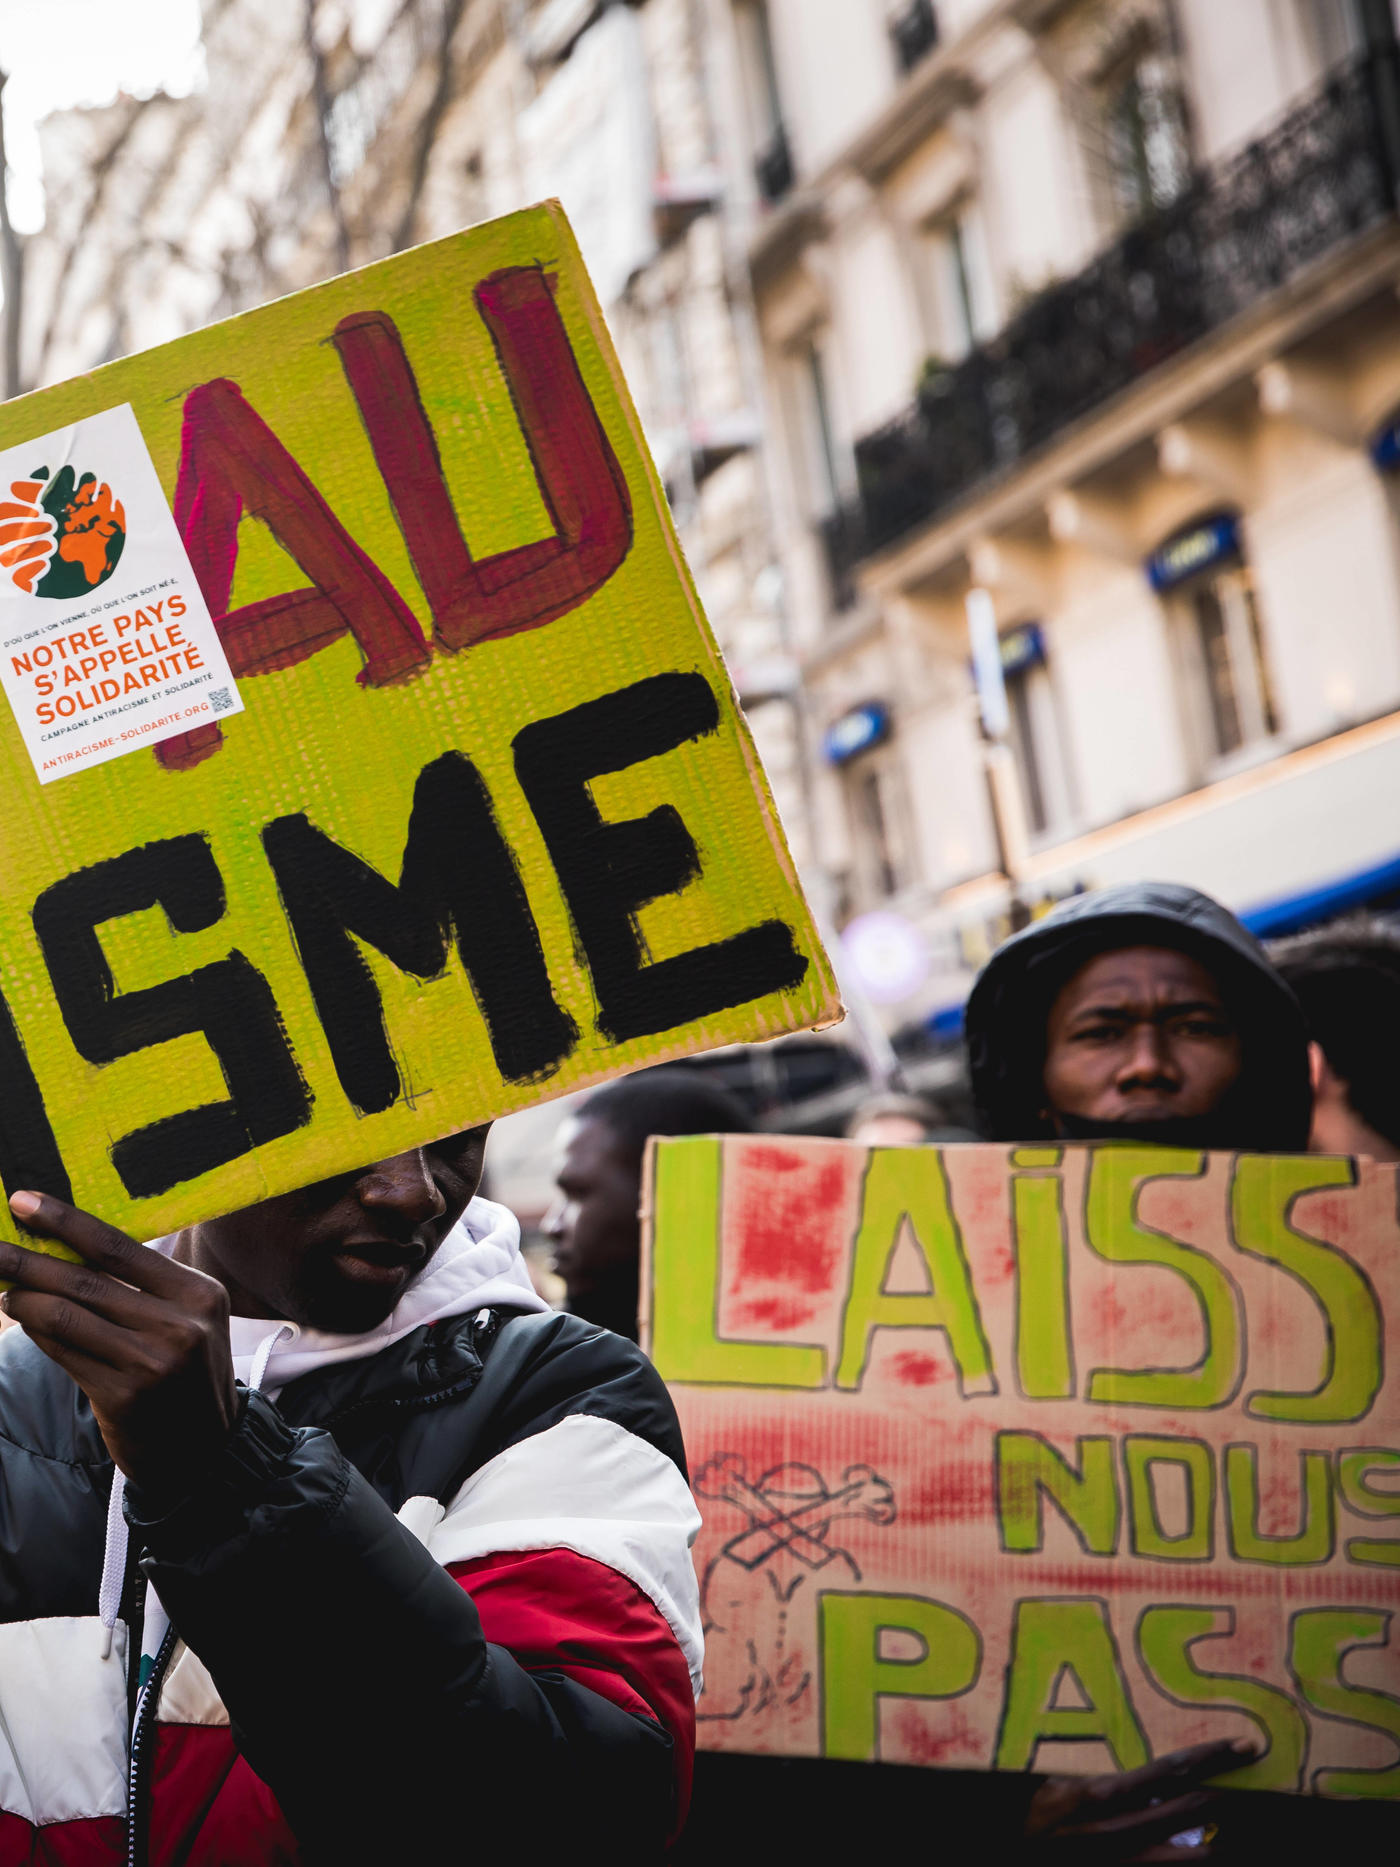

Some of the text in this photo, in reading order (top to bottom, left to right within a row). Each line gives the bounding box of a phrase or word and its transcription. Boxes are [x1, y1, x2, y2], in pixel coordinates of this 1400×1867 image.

[153, 263, 634, 772] AU
[10, 594, 188, 676] NOTRE PAYS
[23, 629, 40, 641] QUE
[40, 621, 59, 634] L'ON
[103, 598, 120, 610] QUE
[120, 592, 139, 603] L'ON
[140, 584, 158, 597] SOIT
[35, 642, 205, 725] SOLIDARITÉ
[40, 719, 90, 743] CAMPAGNE
[92, 697, 150, 724] ANTIRACISME
[152, 691, 162, 701] ET
[42, 701, 209, 771] ANTIRACISME-SOLIDARITE.ORG
[994, 1428, 1400, 1568] NOUS
[817, 1590, 1400, 1799] PASS
